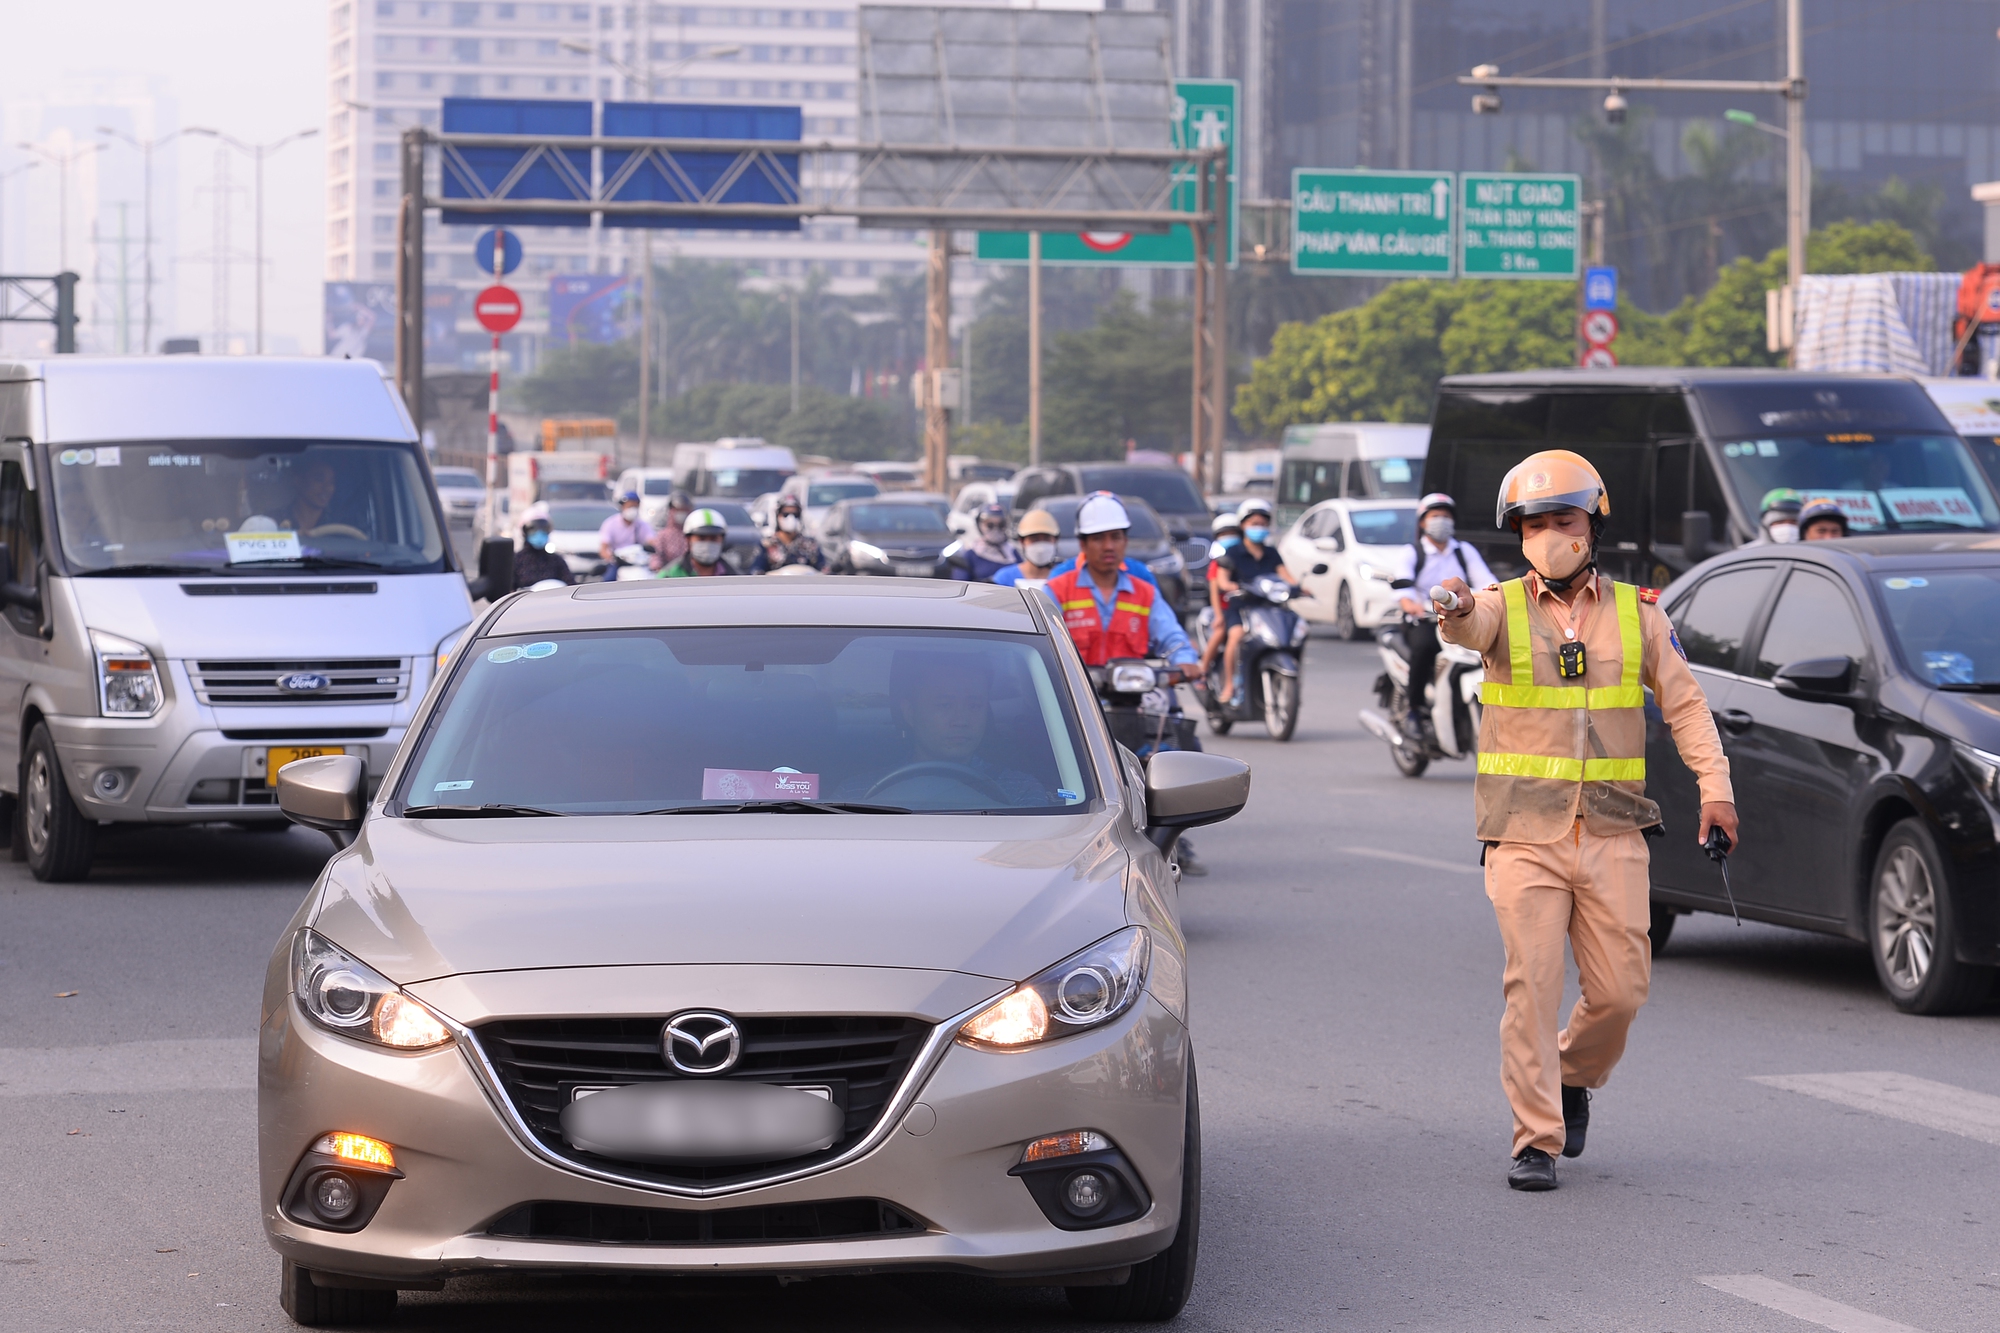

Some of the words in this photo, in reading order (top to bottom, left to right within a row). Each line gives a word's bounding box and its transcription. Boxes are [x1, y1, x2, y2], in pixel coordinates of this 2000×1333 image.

[1476, 179, 1515, 205] NÚT
[1518, 182, 1564, 206] GIAO
[1337, 191, 1400, 214] THANH
[1504, 208, 1534, 228] DUY
[1501, 252, 1513, 270] 3
[238, 540, 266, 549] PVG
[288, 674, 319, 688] Ford
